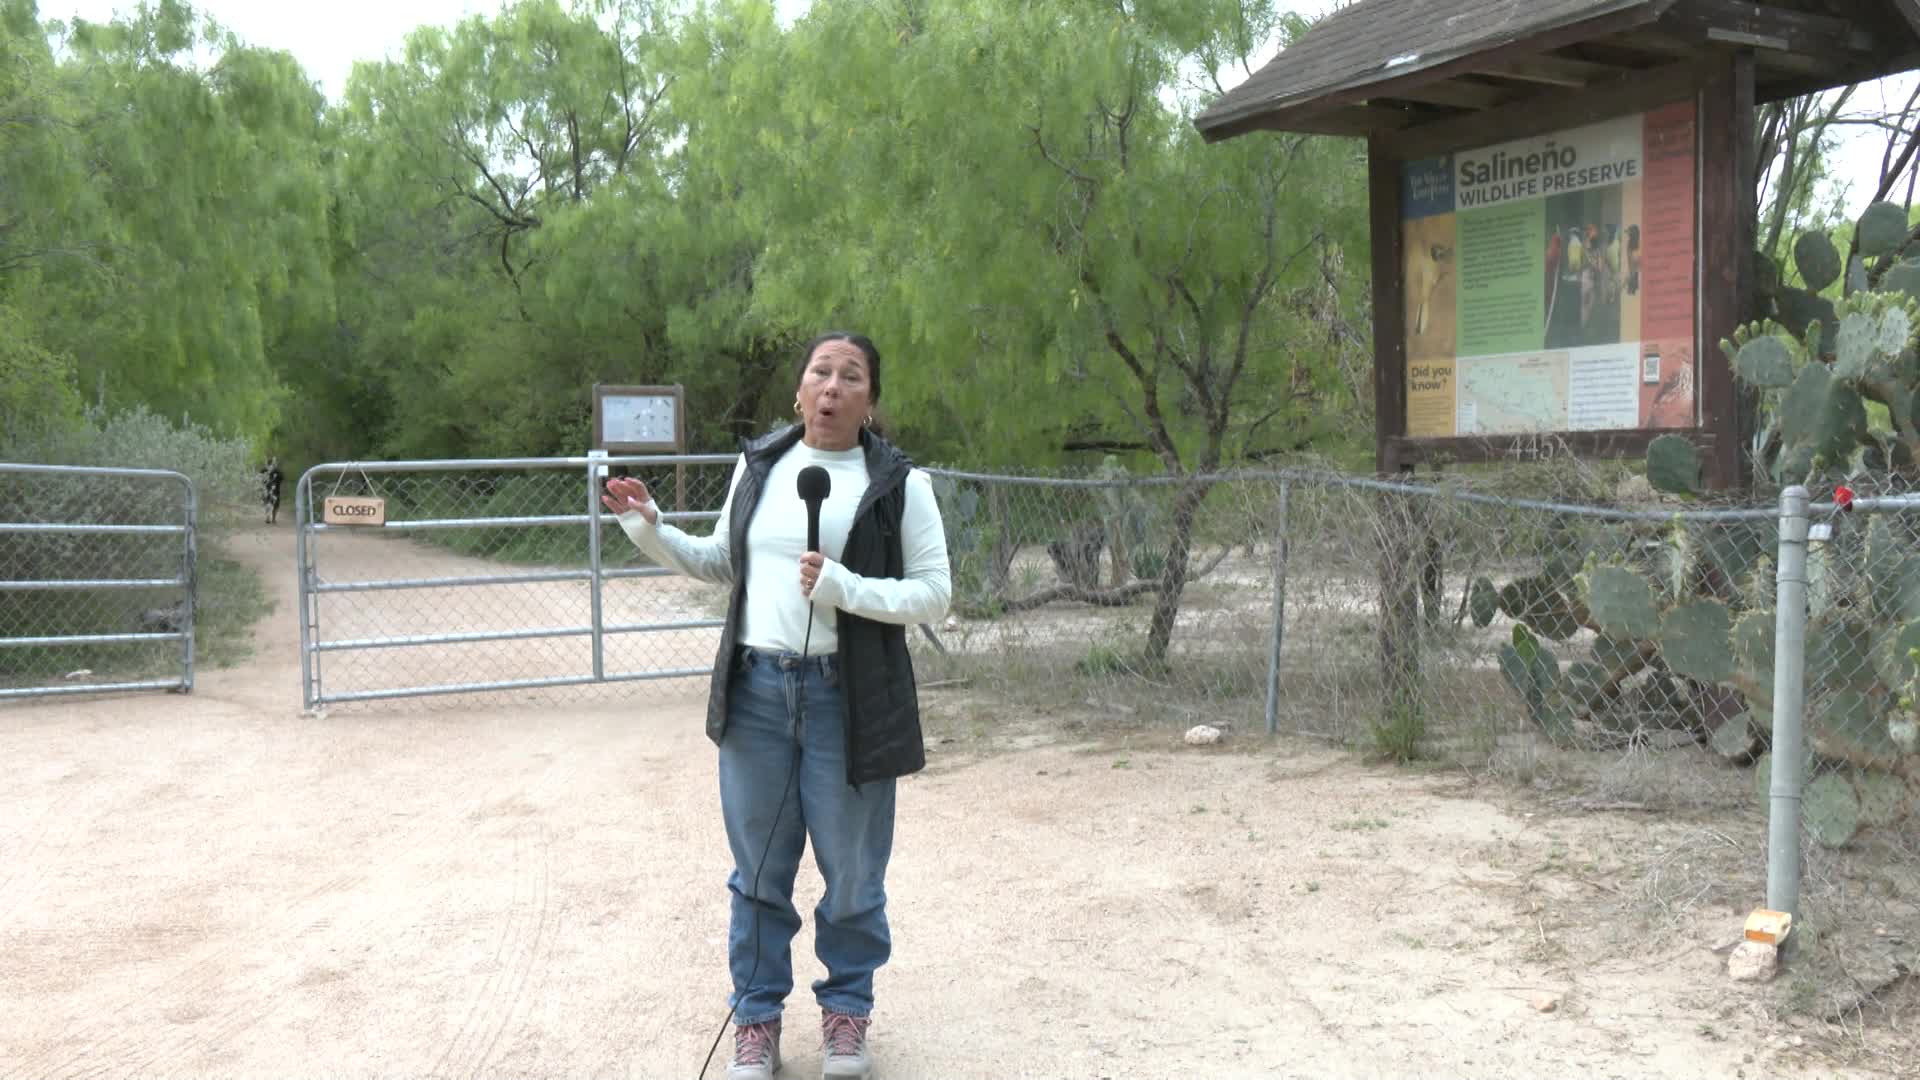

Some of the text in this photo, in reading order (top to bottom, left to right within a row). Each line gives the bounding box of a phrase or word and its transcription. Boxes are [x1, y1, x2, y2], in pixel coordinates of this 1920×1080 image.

[1460, 141, 1577, 187] Salineño
[1459, 179, 1537, 207] WILDLIFE
[1543, 159, 1637, 193] PRESERVE
[1411, 365, 1452, 380] Did you
[333, 505, 377, 516] CLOSED
